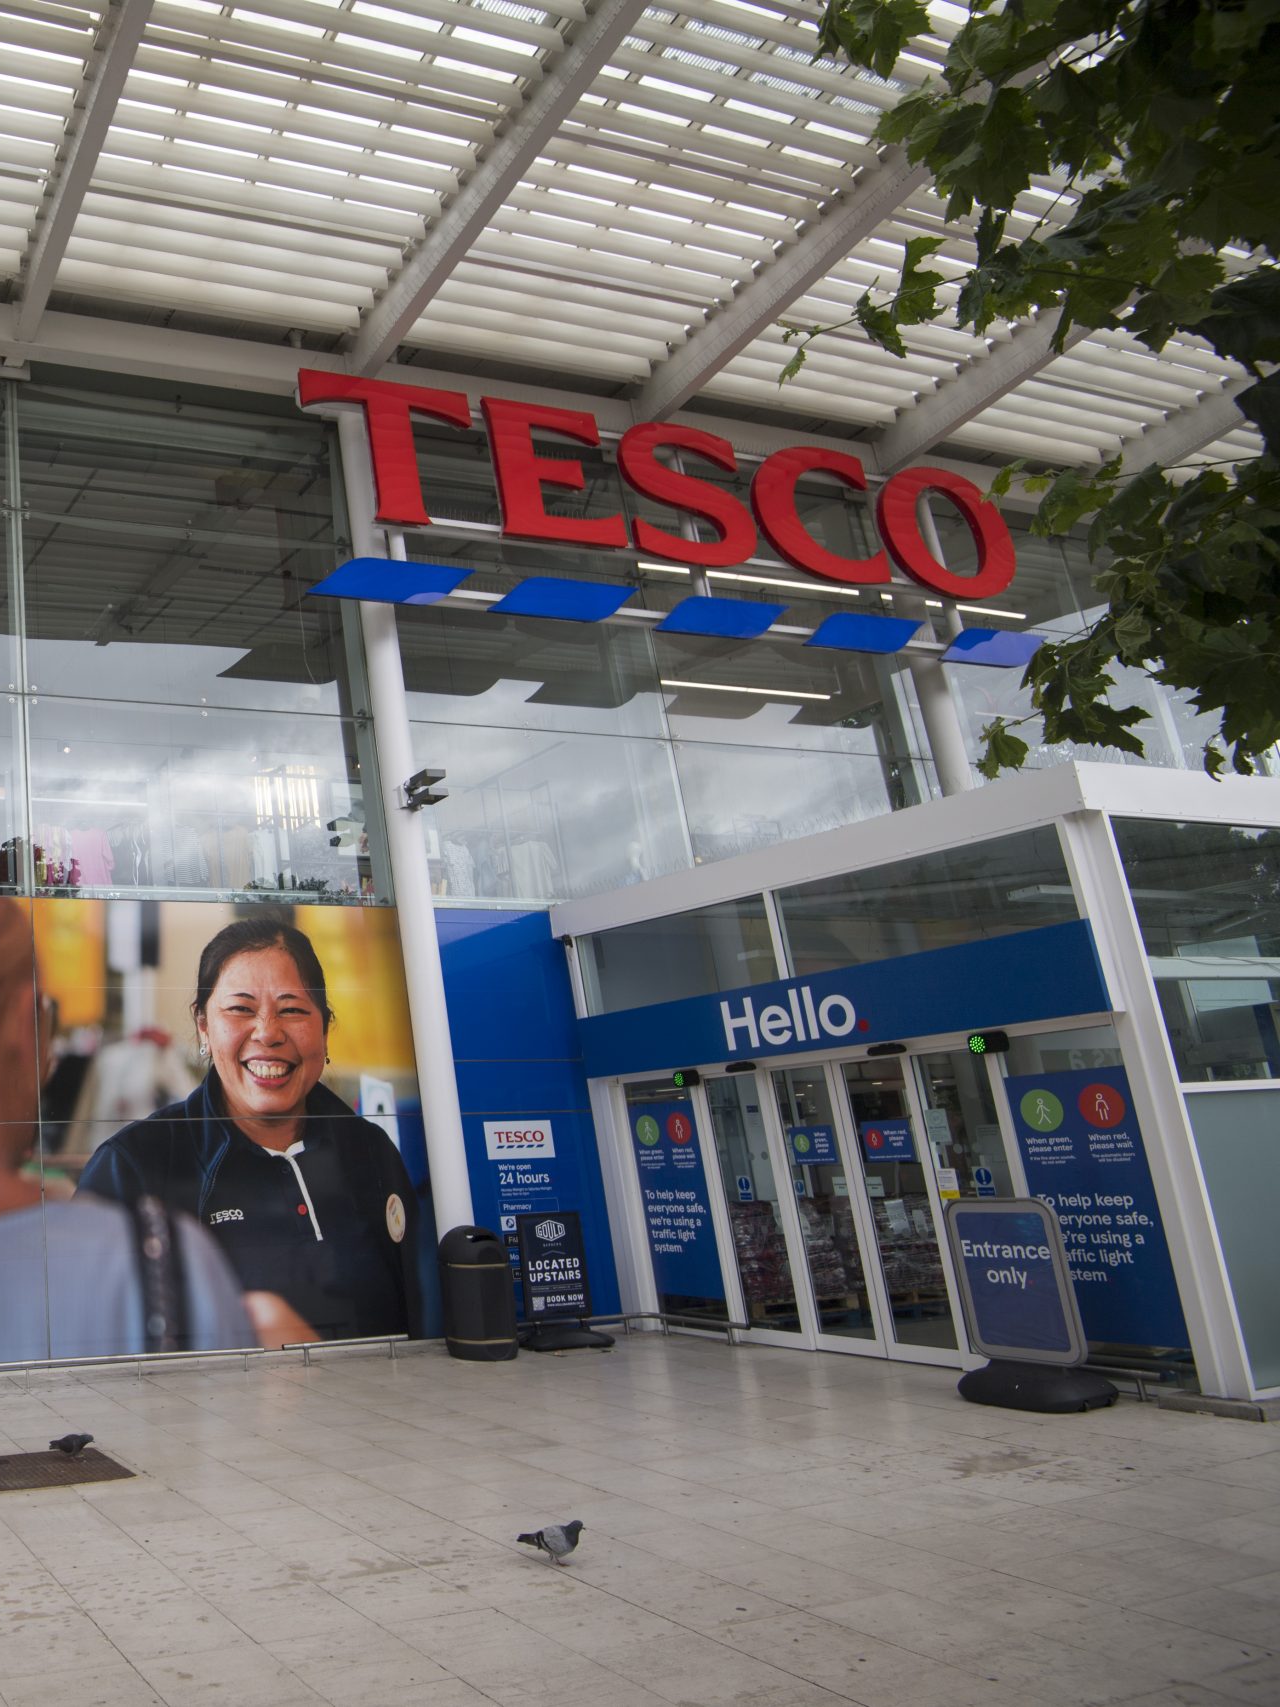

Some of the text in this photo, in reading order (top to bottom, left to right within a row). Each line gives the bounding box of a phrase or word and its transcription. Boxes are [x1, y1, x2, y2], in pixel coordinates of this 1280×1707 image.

[298, 367, 1016, 599] TESCO
[720, 985, 869, 1051] Hello.
[494, 1130, 544, 1143] TESCO
[1025, 1136, 1072, 1145] When green,
[1088, 1132, 1130, 1142] When red,
[1029, 1145, 1052, 1154] please
[1089, 1140, 1133, 1151] please wait
[500, 1172, 550, 1185] 24 hours
[645, 1189, 696, 1202] To help keep
[1058, 1193, 1092, 1209] help
[1094, 1193, 1134, 1209] keep
[503, 1203, 531, 1211] Pharmacy
[648, 1203, 707, 1215] everyone safe,
[210, 1209, 243, 1222] TESCO
[1058, 1212, 1154, 1228] eryone safe,
[650, 1216, 702, 1229] we're using a
[536, 1222, 564, 1239] GOULD
[652, 1229, 696, 1242] traffic light
[1061, 1231, 1145, 1247] e're using a
[961, 1239, 1051, 1260] Entrance
[1065, 1249, 1134, 1266] affic light
[528, 1258, 580, 1271] LOCATED
[529, 1269, 581, 1282] UPSTAIRS
[986, 1266, 1034, 1289] only.
[546, 1293, 584, 1303] BOOK NOW
